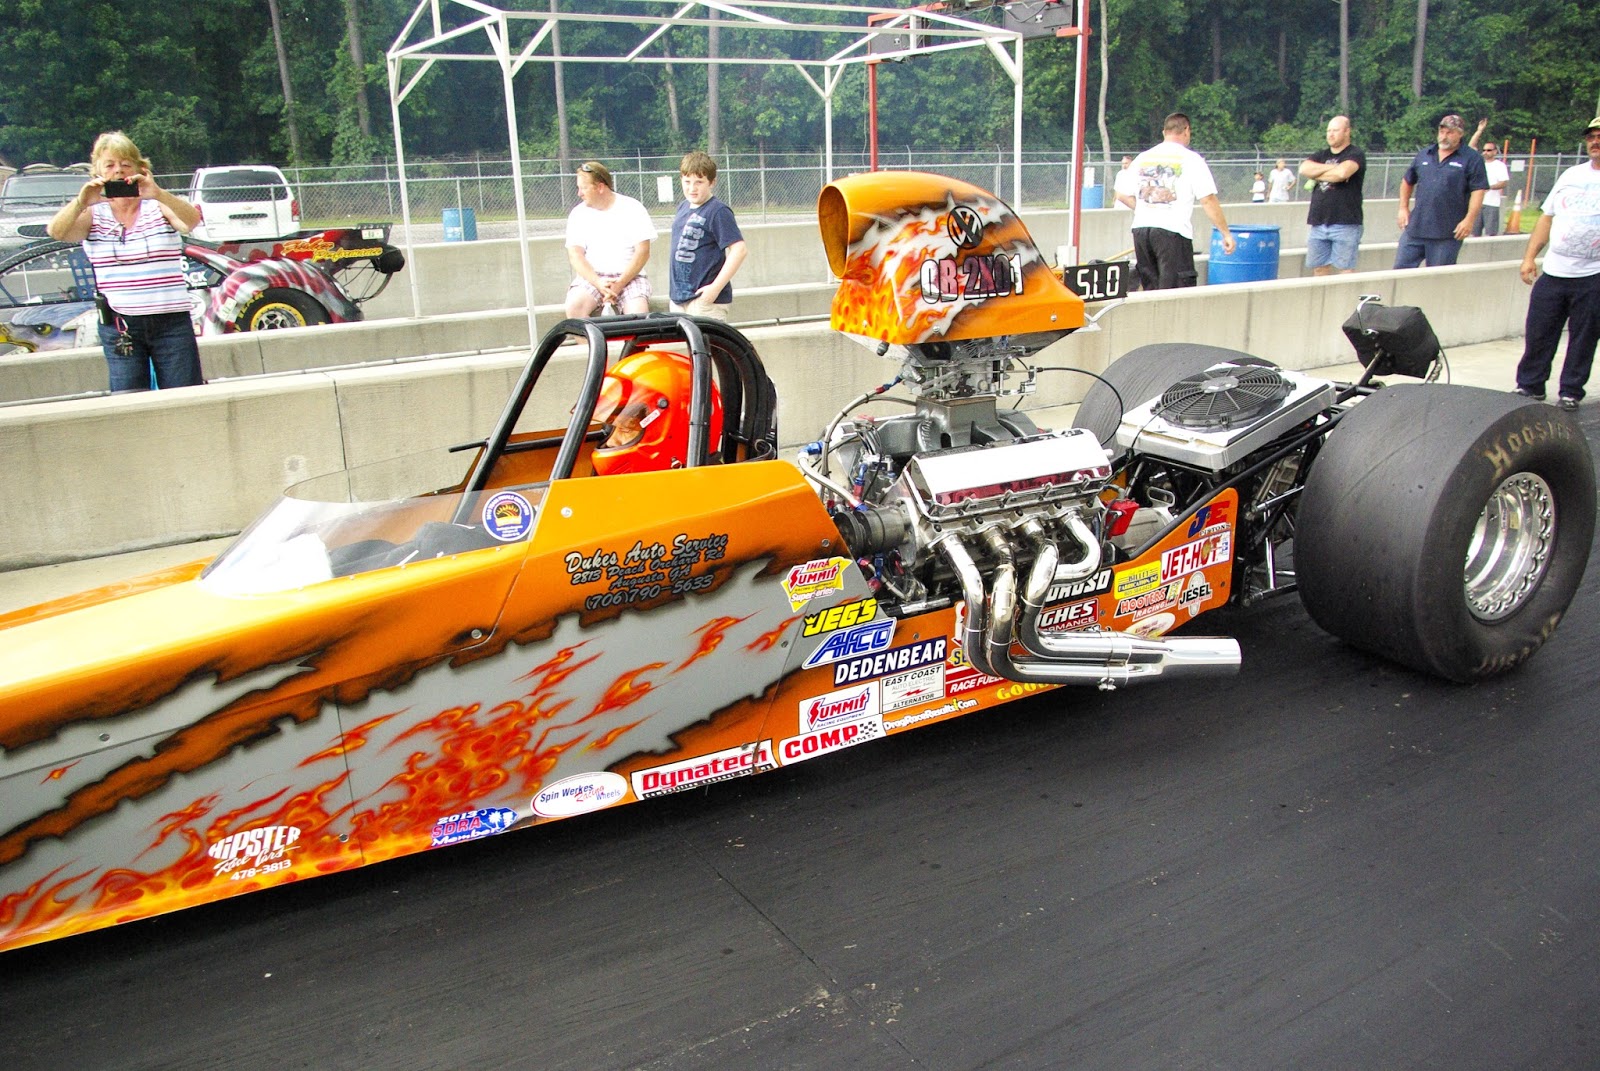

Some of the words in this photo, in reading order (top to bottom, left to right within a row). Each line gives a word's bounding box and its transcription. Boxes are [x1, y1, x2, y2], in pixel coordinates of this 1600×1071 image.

[1200, 522, 1231, 536] PISTONS
[565, 548, 618, 574] Dukes
[624, 540, 666, 566] Auto
[672, 533, 728, 556] Service
[1162, 536, 1222, 581] JET-HOT
[571, 569, 602, 585] 2813
[606, 561, 645, 579] Peach
[650, 552, 699, 570] Orchard
[705, 547, 726, 561] Rd
[806, 560, 830, 571] IHRA
[609, 572, 665, 591] Augusta
[668, 564, 693, 581] GA
[1120, 587, 1167, 613] HOOTERS
[1180, 584, 1211, 605] JESEL
[804, 598, 878, 637] JEG'S
[1135, 600, 1167, 619] RACING
[807, 620, 894, 666] AFCO
[835, 638, 947, 684] DEDENBEAR
[885, 675, 910, 687] EAST
[910, 666, 942, 680] COAST
[892, 683, 908, 691] AUTO
[908, 676, 936, 687] ELECTRIC
[950, 678, 976, 693] RACE
[893, 694, 935, 708] ALTERNATOR
[817, 720, 836, 728] RACING
[836, 712, 865, 723] EQUIPMENT
[784, 724, 858, 759] COMP
[642, 749, 768, 791] Dynatech
[540, 790, 560, 803] Spin
[562, 783, 594, 798] Werkes
[595, 788, 621, 801] Wheels
[431, 816, 482, 839] SDRA
[437, 810, 478, 825] 2013
[431, 828, 496, 847] Member
[229, 859, 292, 881] 478-3813
